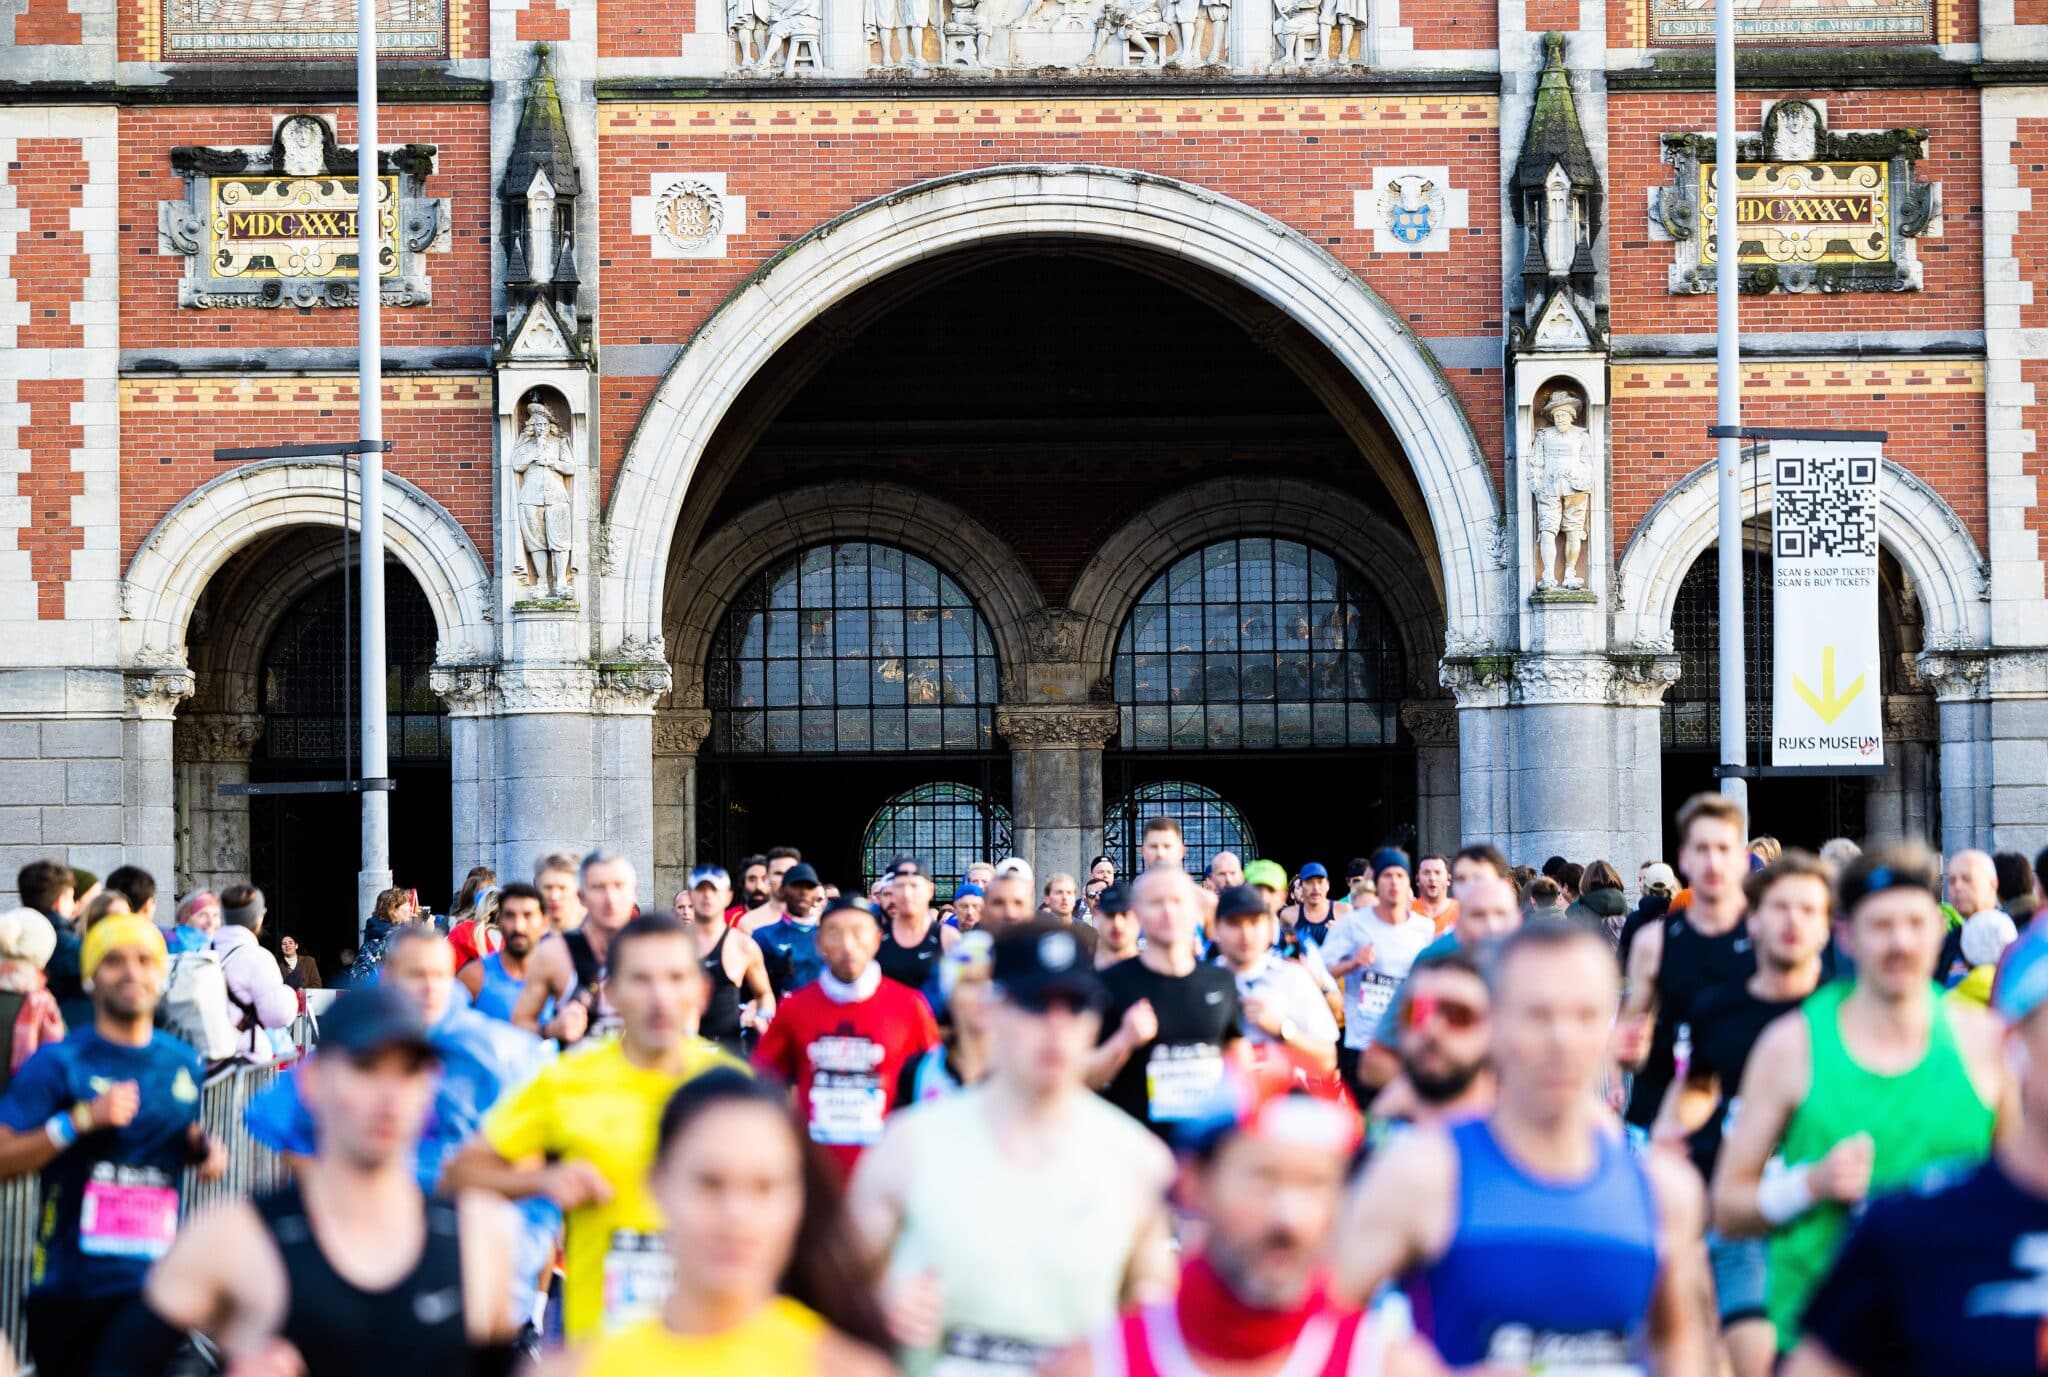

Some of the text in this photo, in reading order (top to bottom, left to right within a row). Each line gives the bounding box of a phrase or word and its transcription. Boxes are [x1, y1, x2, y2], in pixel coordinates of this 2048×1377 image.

[1777, 567, 1876, 577] SCAN & KOOP TICKETS
[1777, 578, 1871, 587] SCAN & BUY TICKETS
[1819, 735, 1879, 749] MUSEUM
